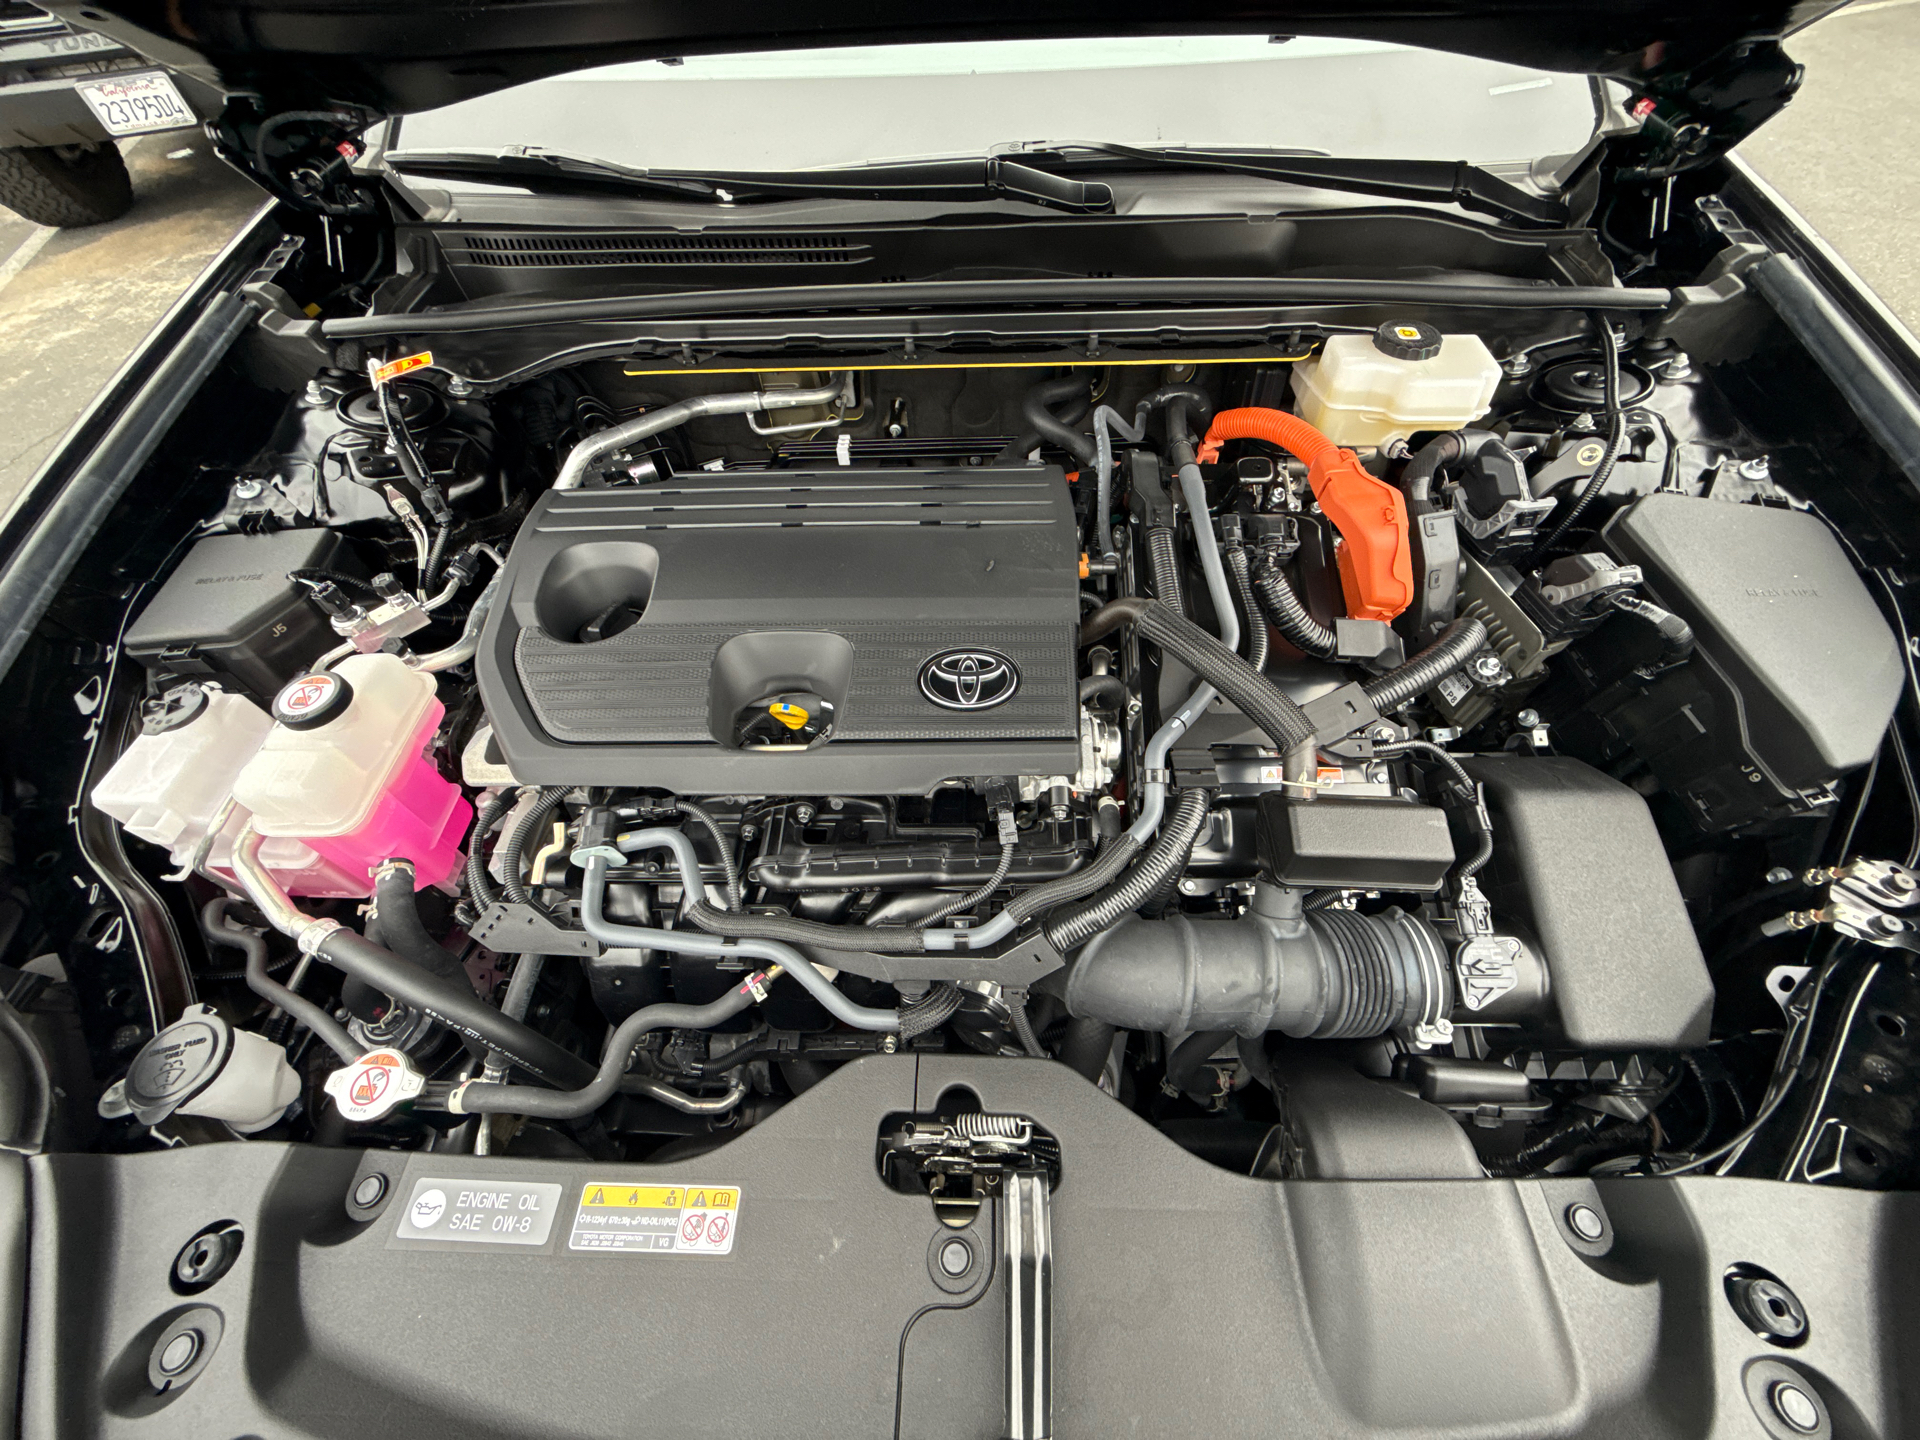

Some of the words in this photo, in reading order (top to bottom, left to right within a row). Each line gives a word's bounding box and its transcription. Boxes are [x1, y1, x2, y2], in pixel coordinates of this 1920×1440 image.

[101, 83, 157, 97] California
[98, 93, 185, 125] 23795D4
[272, 623, 287, 638] J5
[1446, 690, 1458, 704] P8
[1740, 765, 1762, 783] J9
[456, 1191, 512, 1209] ENGINE
[518, 1194, 540, 1211] OIL
[449, 1213, 484, 1231] SAE
[492, 1215, 532, 1233] 0W-8
[659, 1237, 670, 1248] VG
